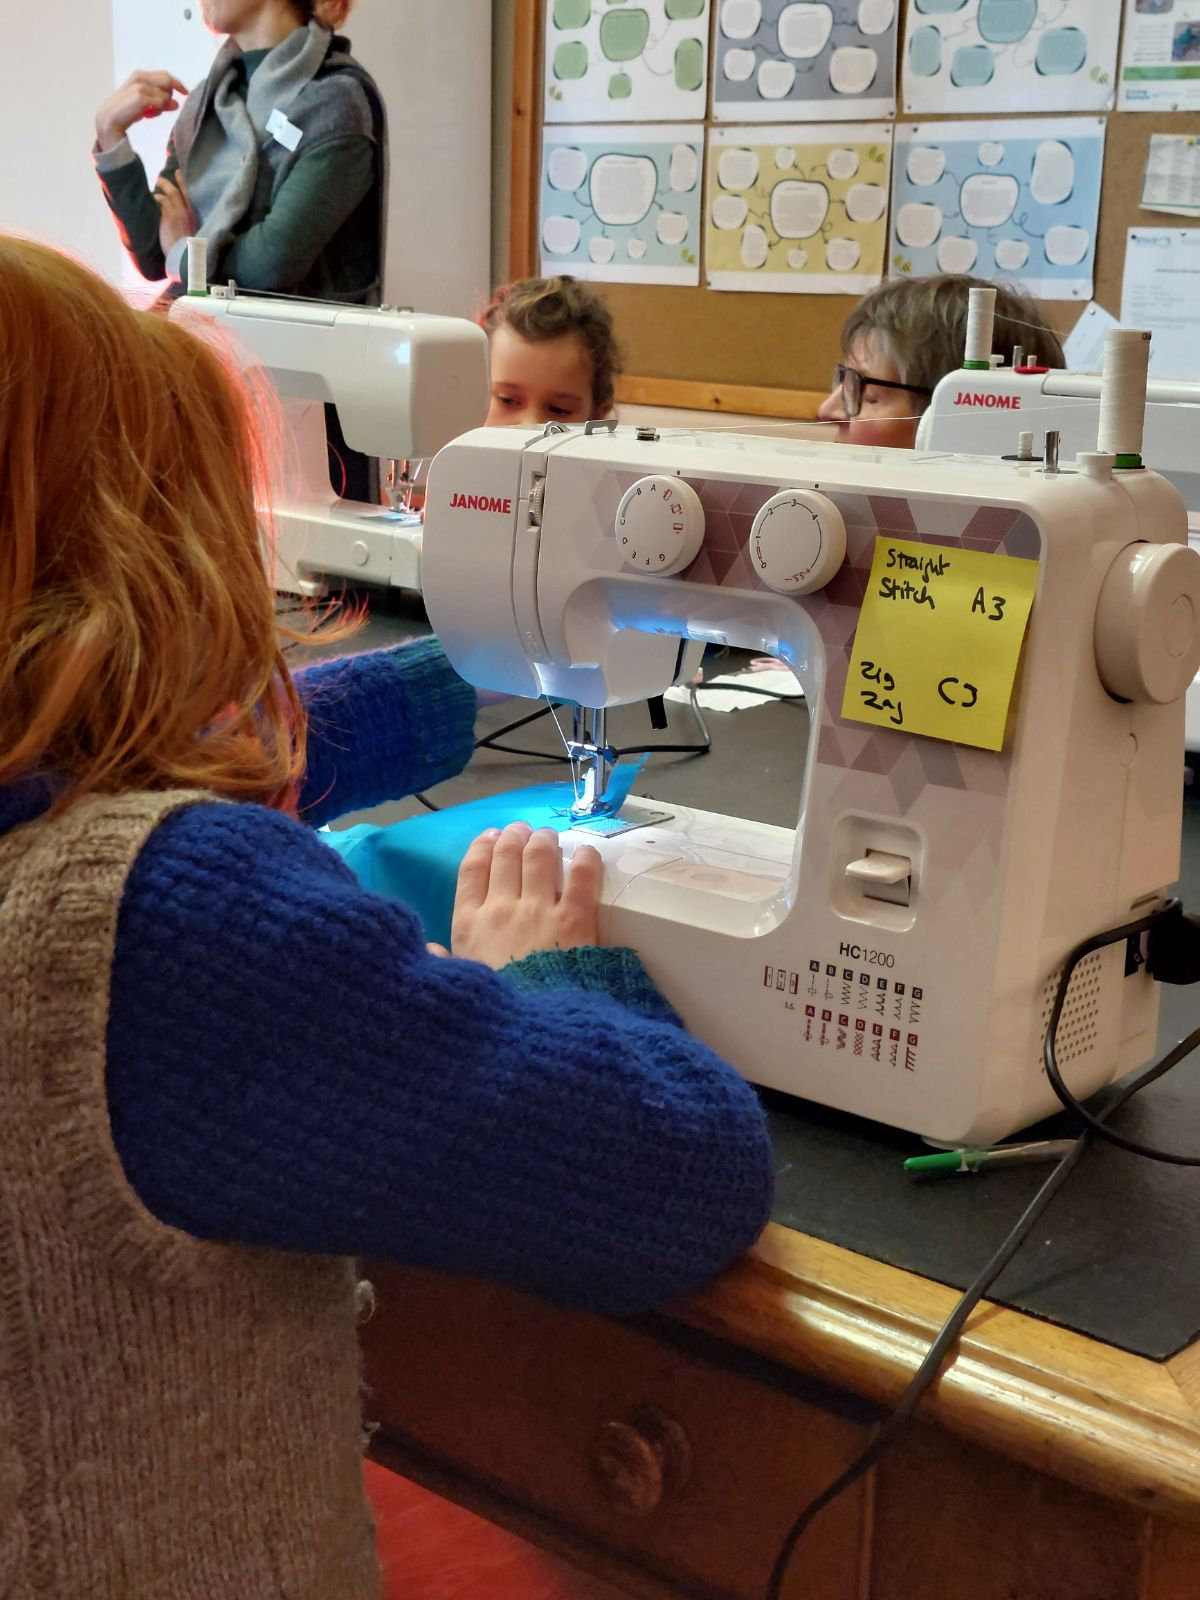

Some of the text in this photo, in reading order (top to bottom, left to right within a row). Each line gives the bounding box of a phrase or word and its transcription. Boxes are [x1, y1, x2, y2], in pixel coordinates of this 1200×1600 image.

[953, 392, 1021, 409] JANOME
[449, 493, 511, 514] JANOME
[886, 548, 950, 583] Straight
[879, 577, 1006, 620] Stitch A3
[840, 942, 894, 968] HC1200
